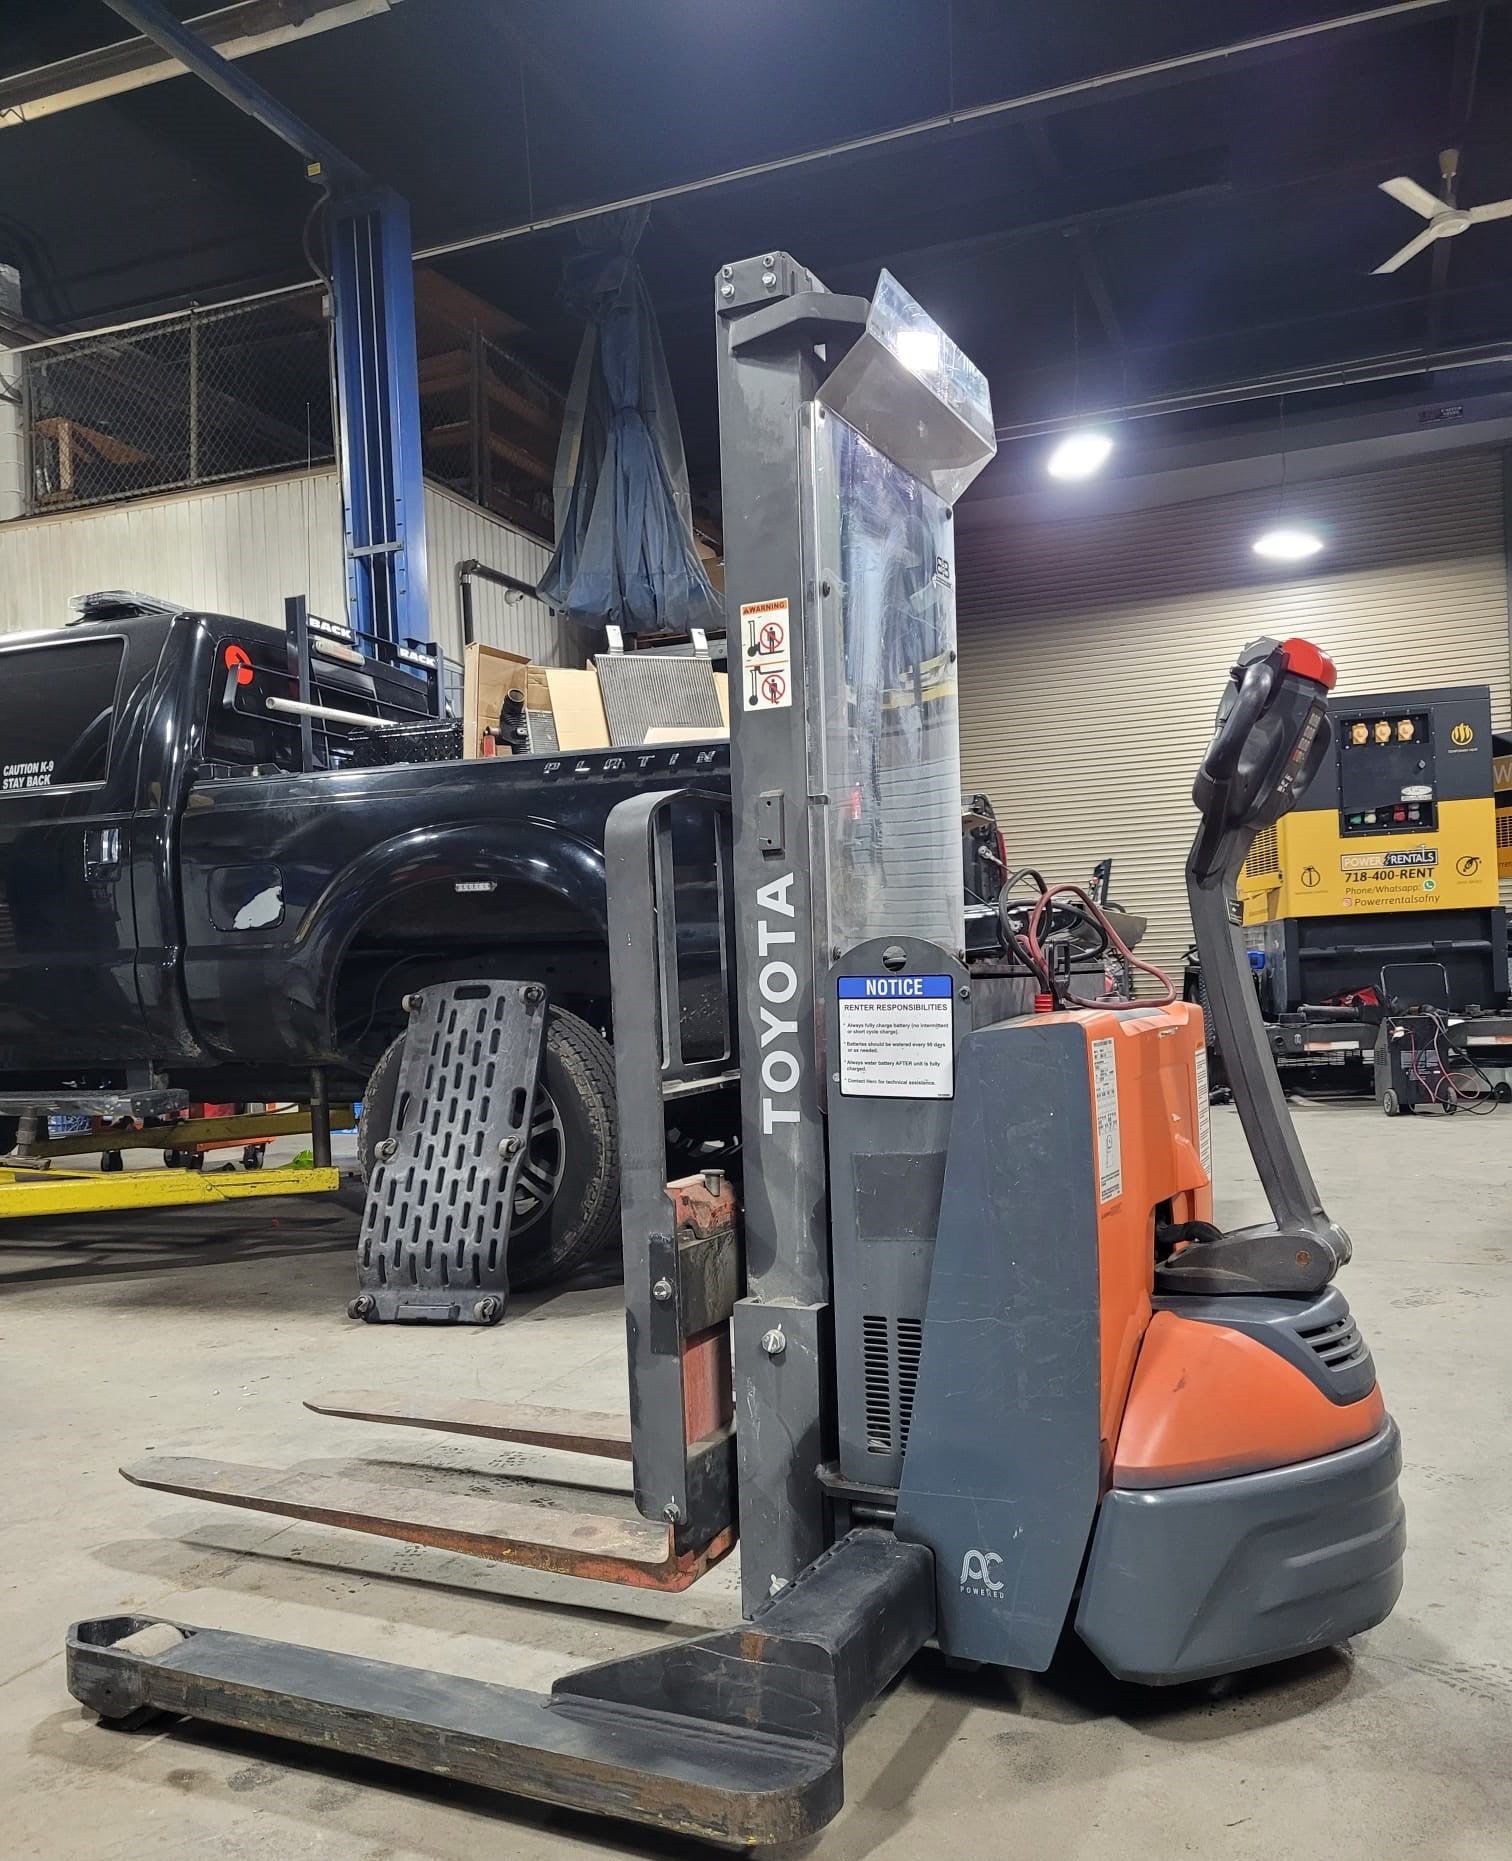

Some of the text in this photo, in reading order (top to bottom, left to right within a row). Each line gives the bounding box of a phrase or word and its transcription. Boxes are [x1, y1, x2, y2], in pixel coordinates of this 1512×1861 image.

[748, 601, 785, 612] WARNING
[309, 617, 435, 666] BACK RACK
[3, 760, 54, 777] CAUTION K-9
[543, 750, 717, 774] PLATIN
[2, 774, 51, 790] STAY BACK
[1344, 852, 1434, 867] POWER RENTALS
[1345, 868, 1435, 883] 718-400-RENT
[1354, 894, 1440, 906] Powerrentalsofny
[866, 978, 923, 996] NOTICE
[756, 872, 800, 1135] TOYOTA
[876, 1003, 948, 1011] RESPONSIBILITIES
[960, 1549, 1004, 1591] AC
[960, 1585, 1004, 1599] POWERED
